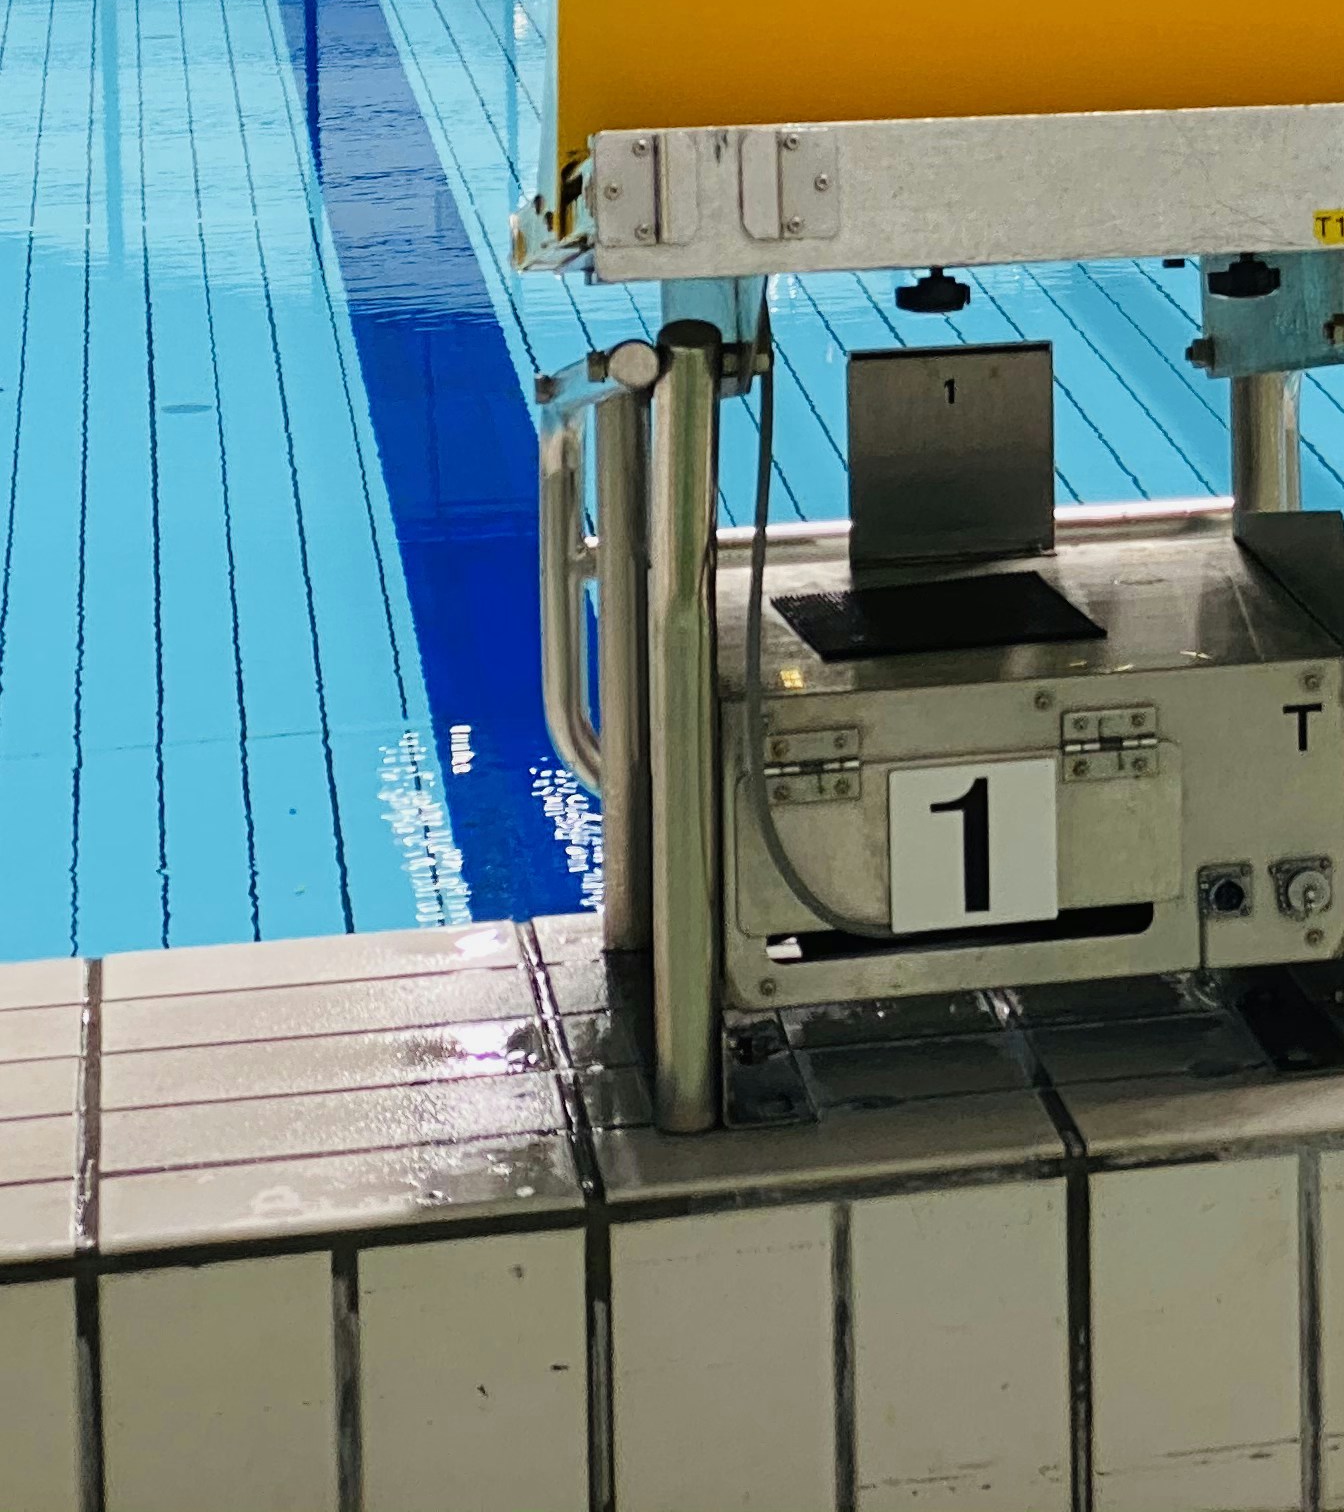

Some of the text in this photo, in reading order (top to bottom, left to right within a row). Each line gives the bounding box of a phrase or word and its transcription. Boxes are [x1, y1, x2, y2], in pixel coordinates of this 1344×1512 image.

[1315, 216, 1344, 237] T1
[944, 378, 955, 404] 1
[1282, 702, 1323, 752] T
[929, 776, 990, 912] 1
